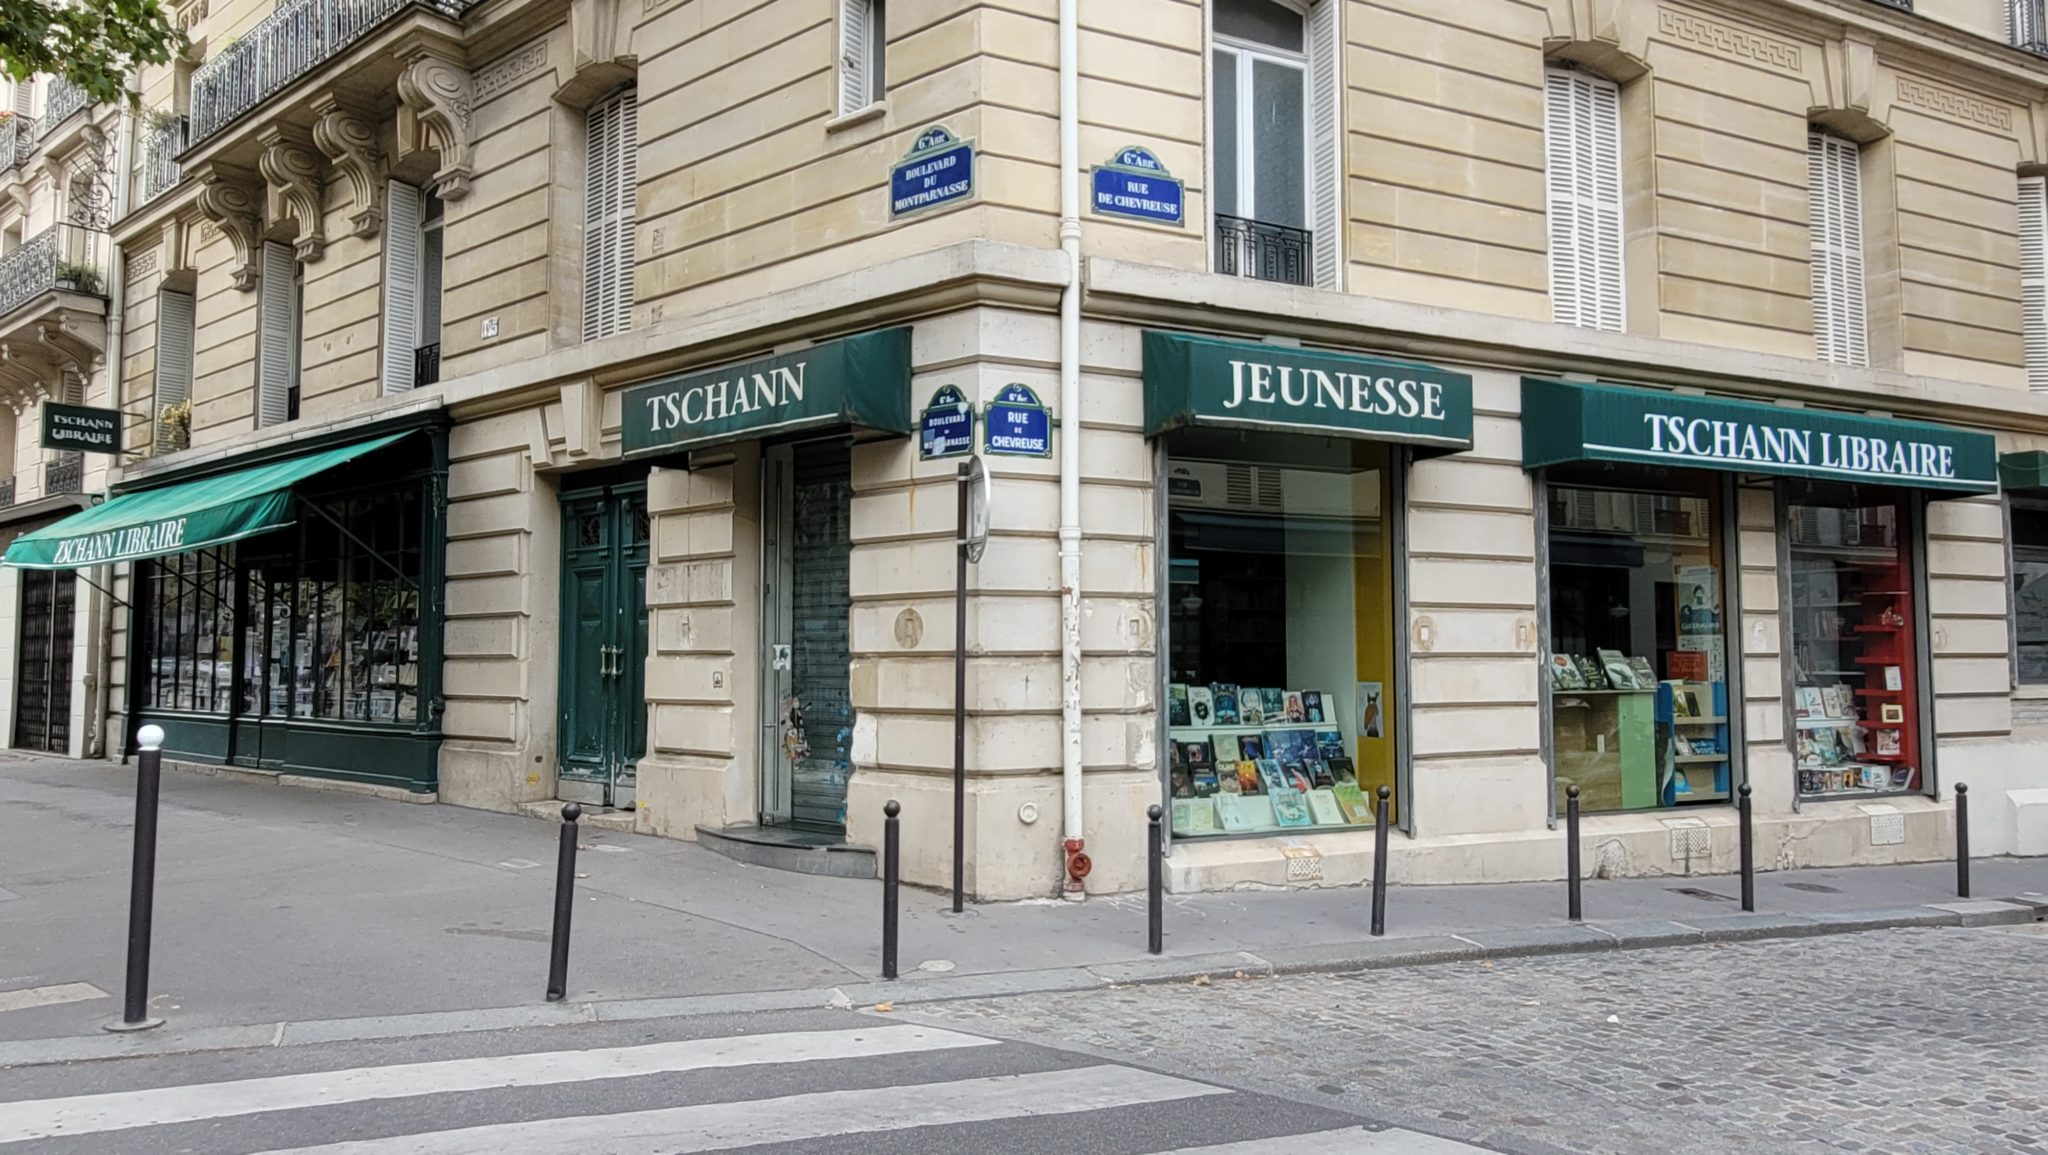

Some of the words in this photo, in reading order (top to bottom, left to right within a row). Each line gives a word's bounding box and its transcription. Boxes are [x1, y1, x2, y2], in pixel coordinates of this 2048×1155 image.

[905, 155, 957, 181] BOULEVARD
[923, 174, 938, 189] DU
[1127, 181, 1149, 195] RUE
[894, 179, 969, 212] MONTPARNASSE
[1097, 191, 1113, 205] DE
[1114, 195, 1178, 215] CHEVREUSE
[646, 362, 807, 432] TSCHANN
[1222, 360, 1445, 421] JEUNESSE
[53, 414, 114, 430] TSCHANN
[1007, 411, 1029, 424] RUE
[51, 428, 113, 445] LIBRAIRE
[1013, 426, 1023, 434] DE
[991, 435, 1045, 450] CHEVREUSE
[1643, 413, 1812, 465] TSCHANN
[1819, 432, 1955, 478] LIBRAIRE
[53, 531, 116, 564] TSCHANN
[115, 517, 187, 556] LIBRAIRE
